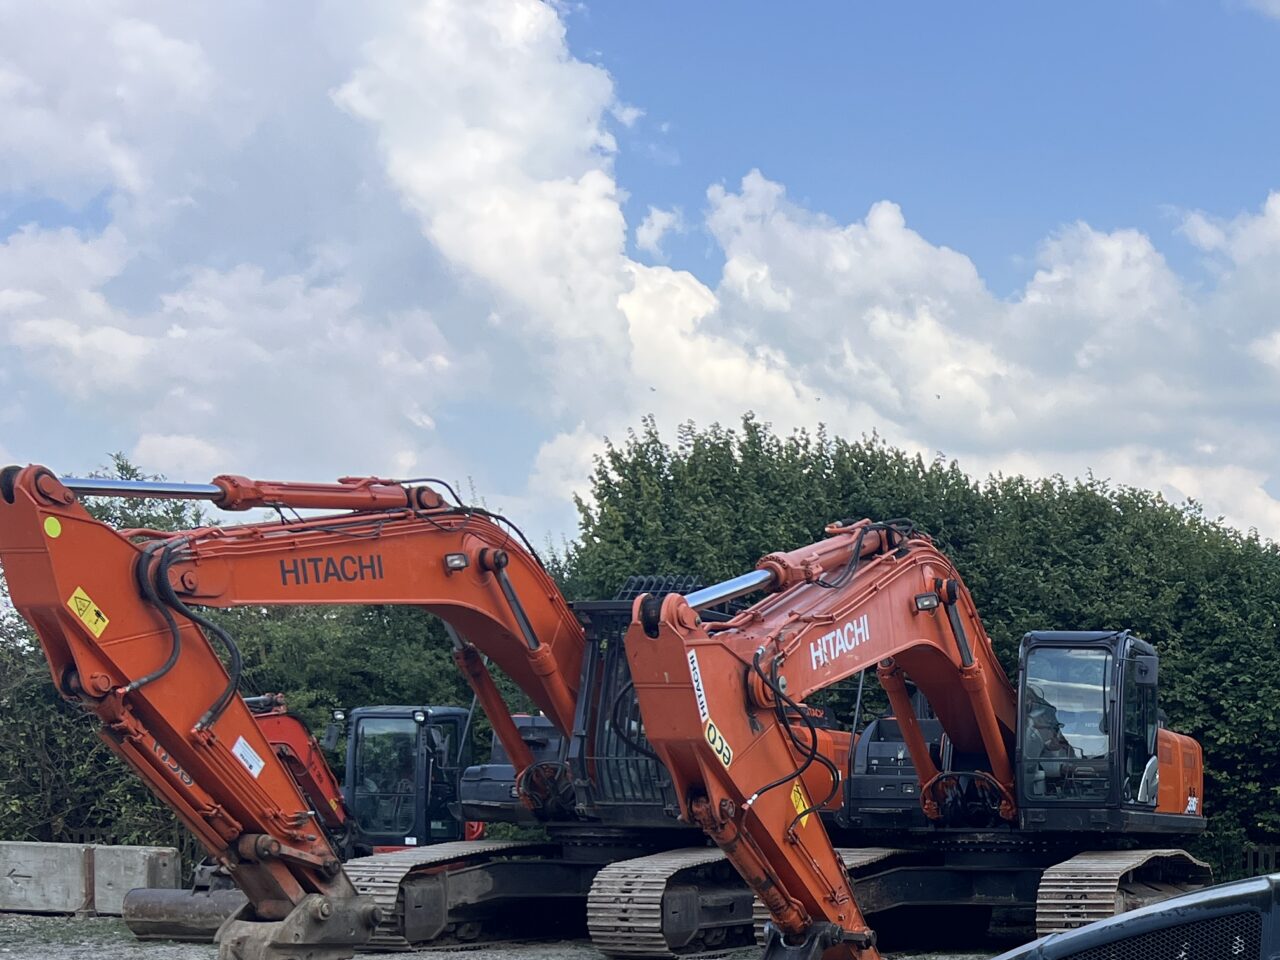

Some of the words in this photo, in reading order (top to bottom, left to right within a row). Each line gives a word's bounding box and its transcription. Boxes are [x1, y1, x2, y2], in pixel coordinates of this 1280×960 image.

[280, 555, 384, 586] HITACHI
[810, 614, 870, 671] HITACHI
[689, 654, 707, 718] HITACHI
